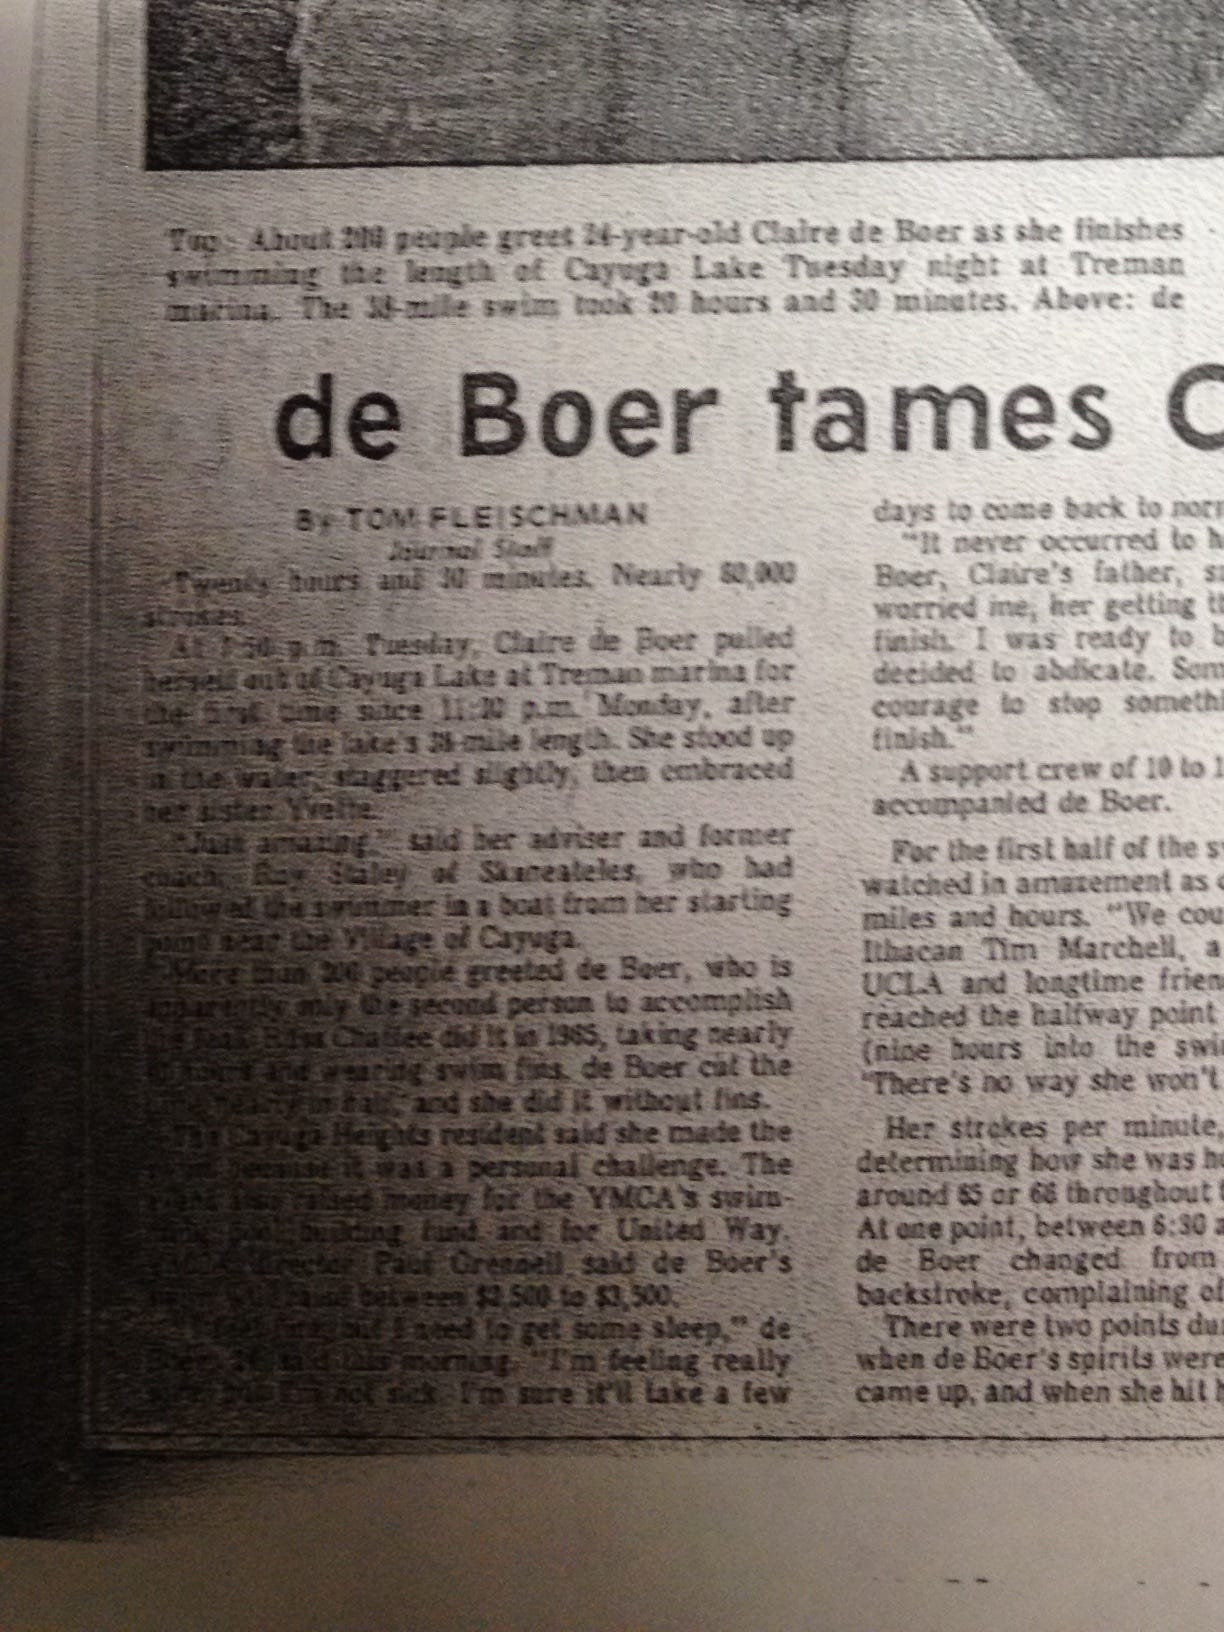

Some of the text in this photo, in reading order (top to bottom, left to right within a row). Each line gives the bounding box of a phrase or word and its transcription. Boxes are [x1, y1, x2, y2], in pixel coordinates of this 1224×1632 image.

[495, 224, 576, 255] greet
[752, 219, 840, 246] Claire
[849, 219, 883, 244] de
[895, 217, 964, 244] Boer
[974, 223, 1005, 245] as
[1014, 218, 1062, 243] she
[1073, 217, 1183, 242] finishes
[164, 250, 1185, 291] swimming the length of Cayuga Lake Tuesday night at Treman
[300, 294, 352, 320] The
[482, 294, 560, 318] swim
[574, 293, 634, 316] took
[691, 290, 772, 315] hours
[782, 288, 836, 314] and
[893, 288, 1019, 313] minutes.
[1030, 286, 1135, 311] Above:
[1150, 285, 1185, 310] de
[276, 374, 399, 463] de
[461, 372, 719, 458] Boer
[769, 368, 1112, 454] tames
[346, 505, 418, 532] TOM
[428, 502, 649, 530] FLEISCHMAN
[862, 939, 963, 964] Ithacan
[984, 935, 1037, 962] Tim
[1059, 935, 1183, 962] Marchell,
[1207, 939, 1221, 958] a
[863, 1039, 931, 1067] (nine
[952, 1037, 1022, 1061] hours
[1045, 1036, 1093, 1060] into
[1116, 1035, 1156, 1059] the
[856, 1283, 1011, 1309] backstroke,
[1023, 1281, 1188, 1310] complaining
[1200, 1276, 1224, 1304] of
[855, 1385, 930, 1404] came
[938, 1383, 976, 1409] up,
[984, 1379, 1033, 1404] and
[1042, 1380, 1110, 1404] when
[1120, 1378, 1163, 1403] she
[1171, 1378, 1207, 1403] hit
